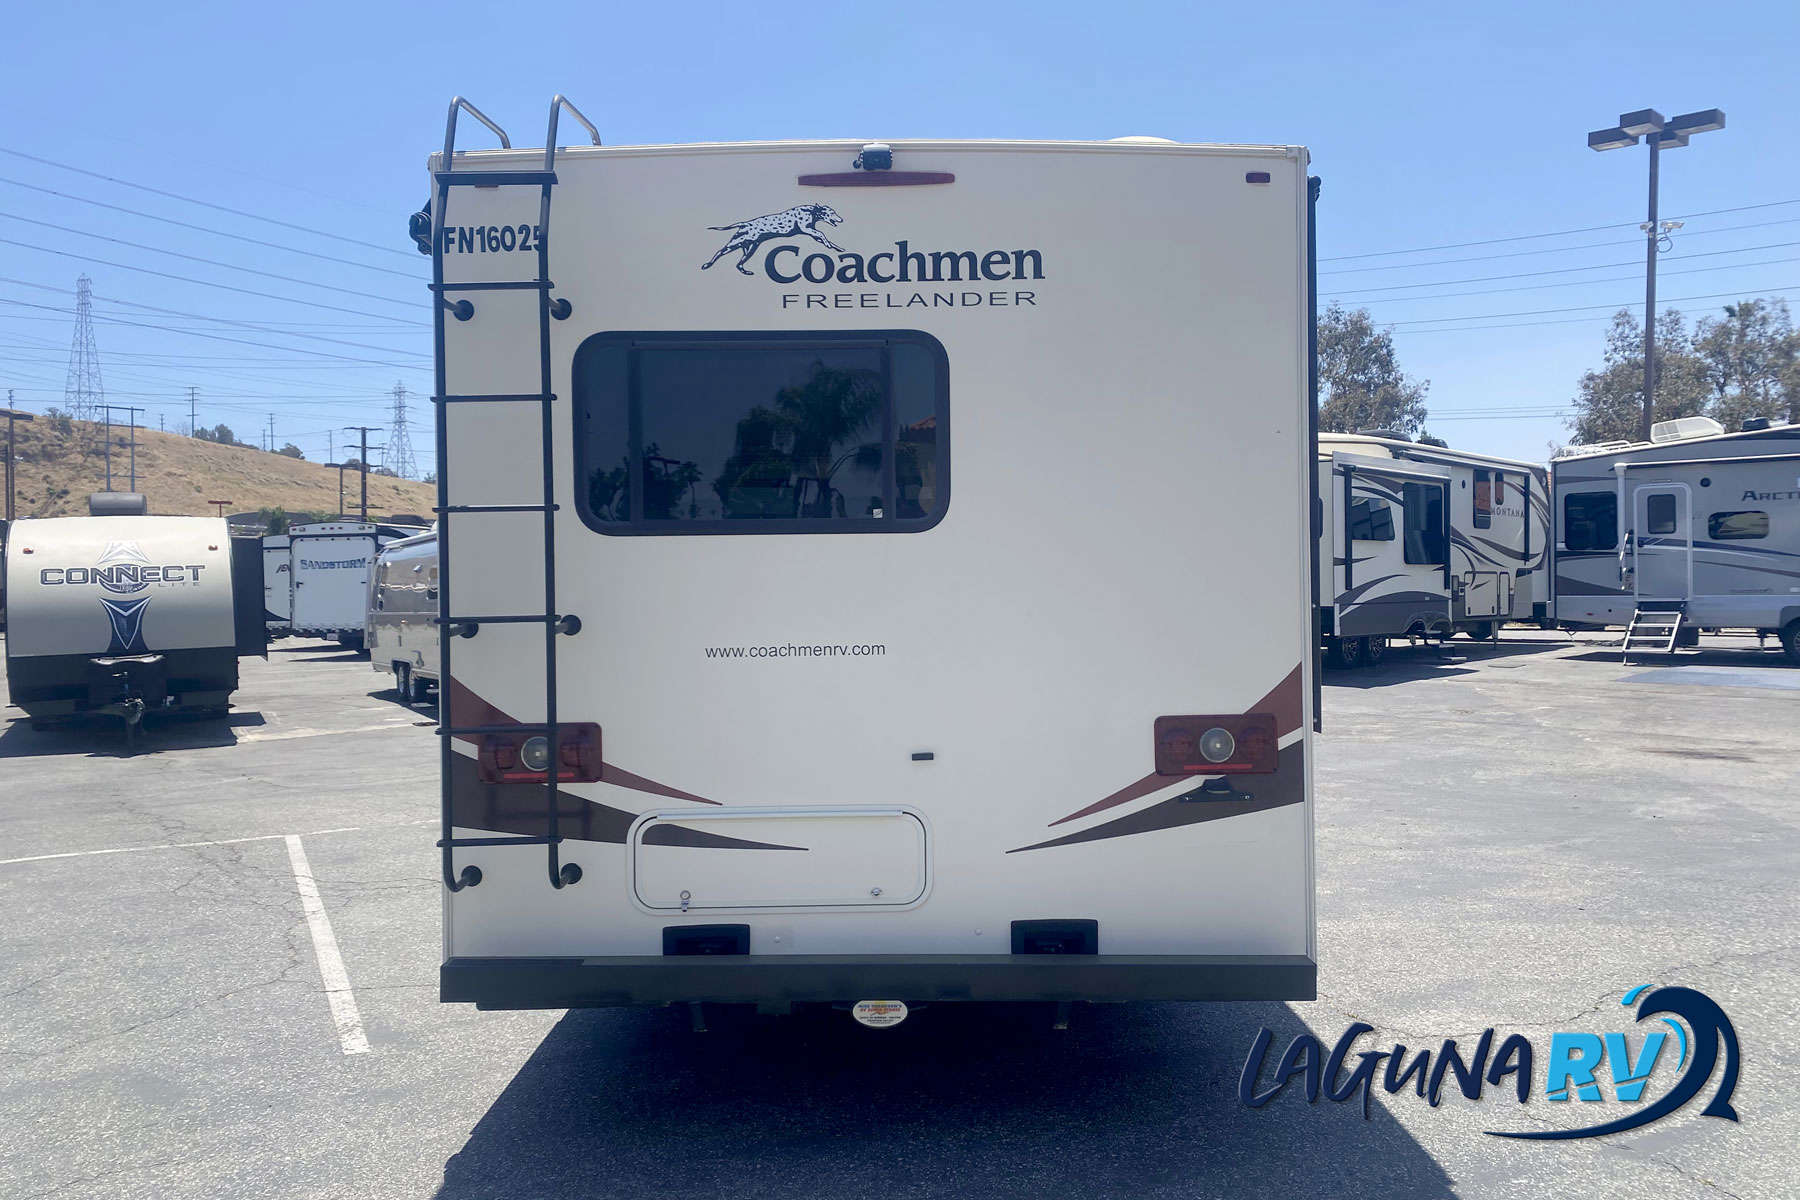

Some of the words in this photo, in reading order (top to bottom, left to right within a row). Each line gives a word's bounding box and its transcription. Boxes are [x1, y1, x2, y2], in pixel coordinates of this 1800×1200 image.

[764, 240, 1046, 284] Coachmen
[782, 291, 1037, 309] FREELANDER
[300, 558, 366, 569] SANDSTORM
[40, 565, 206, 585] CONNECT
[705, 643, 886, 658] www.coachmenrv.com
